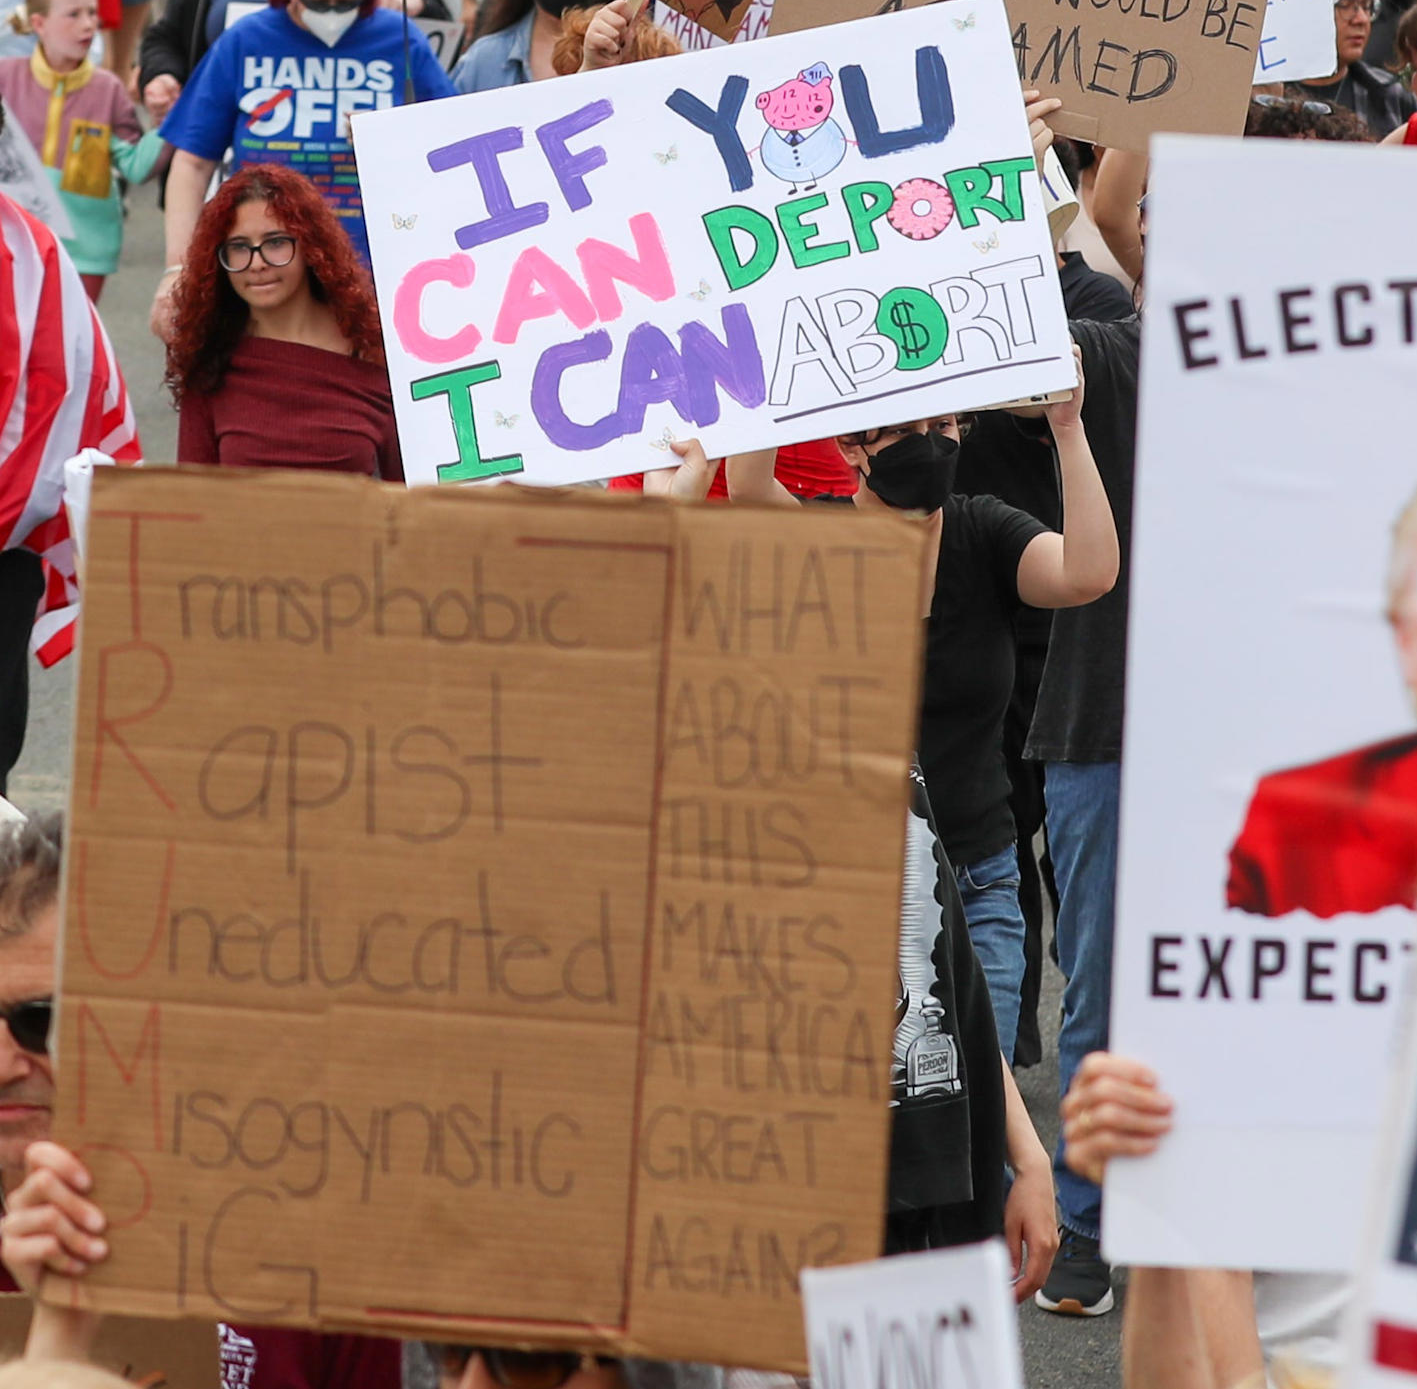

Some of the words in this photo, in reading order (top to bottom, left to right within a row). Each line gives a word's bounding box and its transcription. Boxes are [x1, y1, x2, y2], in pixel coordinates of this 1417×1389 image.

[242, 56, 395, 92] HANDS
[807, 70, 823, 81] 911
[426, 98, 615, 250] IF
[392, 210, 677, 364] CAN
[701, 155, 1036, 293] DEPORT
[410, 360, 524, 484] I
[529, 302, 767, 453] CAN
[768, 254, 1046, 407] ABORT
[680, 538, 900, 657] WHAT
[668, 676, 883, 791] ABOUT
[661, 799, 817, 892] THIS
[661, 901, 857, 1002] MAKES
[1148, 934, 1413, 1004] EXPEC
[649, 994, 882, 1103] AMERICA
[640, 1106, 836, 1189] GREAT
